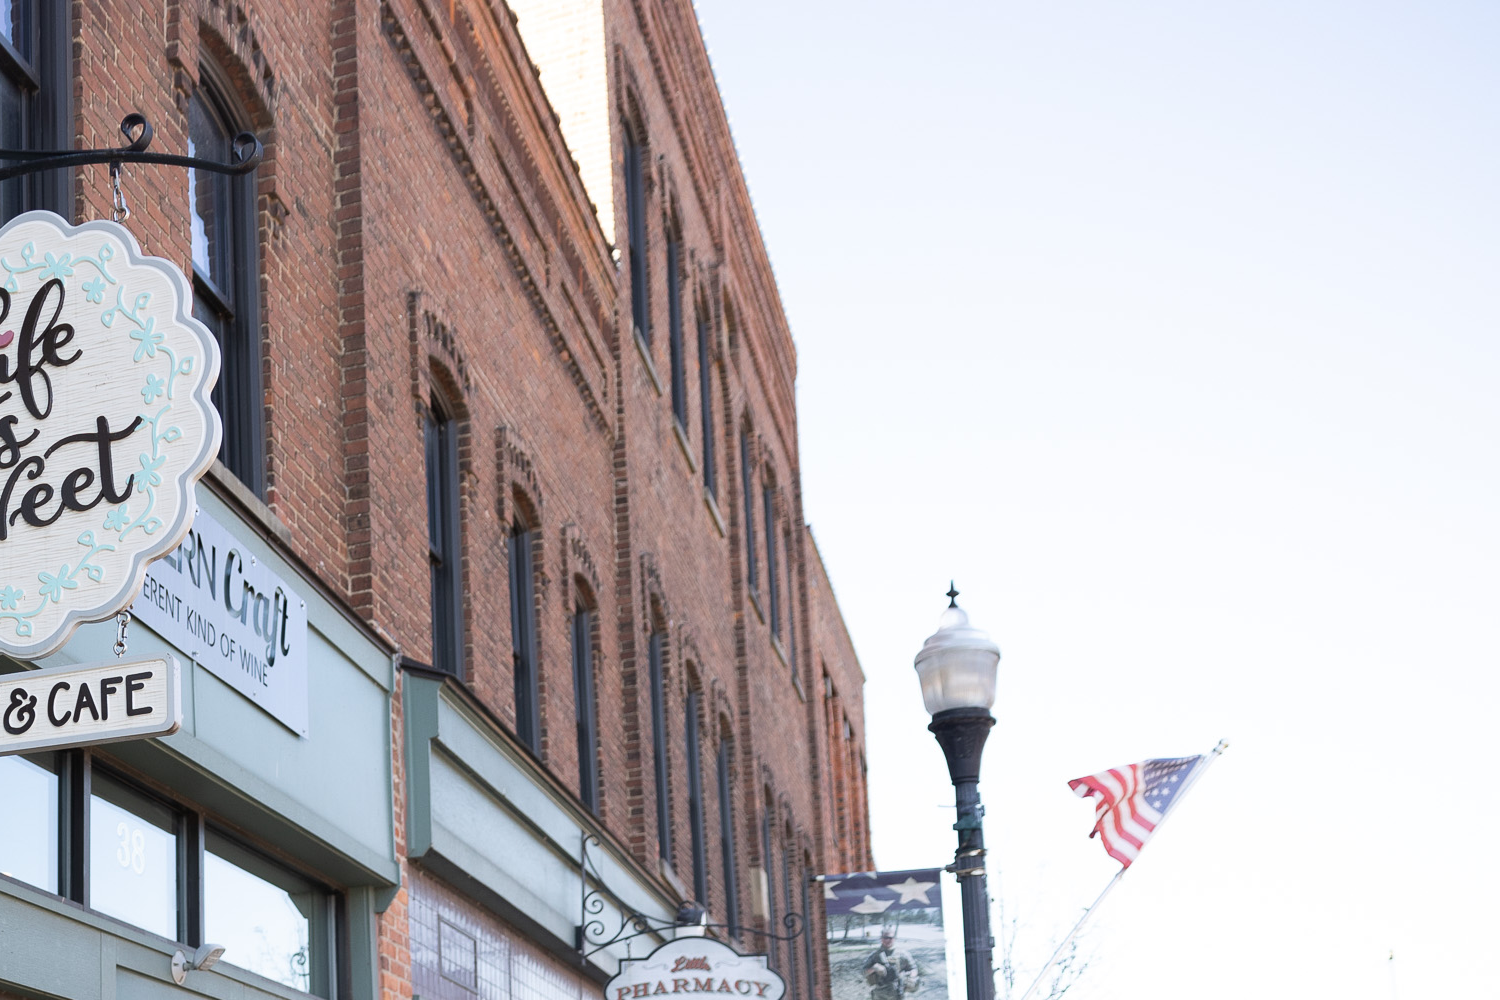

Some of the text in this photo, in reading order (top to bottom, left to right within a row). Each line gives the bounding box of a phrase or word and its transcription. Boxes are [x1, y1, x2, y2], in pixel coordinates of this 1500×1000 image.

[162, 528, 290, 667] RN Craft
[187, 606, 216, 647] KIND
[220, 633, 236, 662] OF
[239, 645, 268, 687] WINE
[2, 688, 38, 736] &
[46, 671, 154, 729] CAFE
[117, 822, 145, 875] 38
